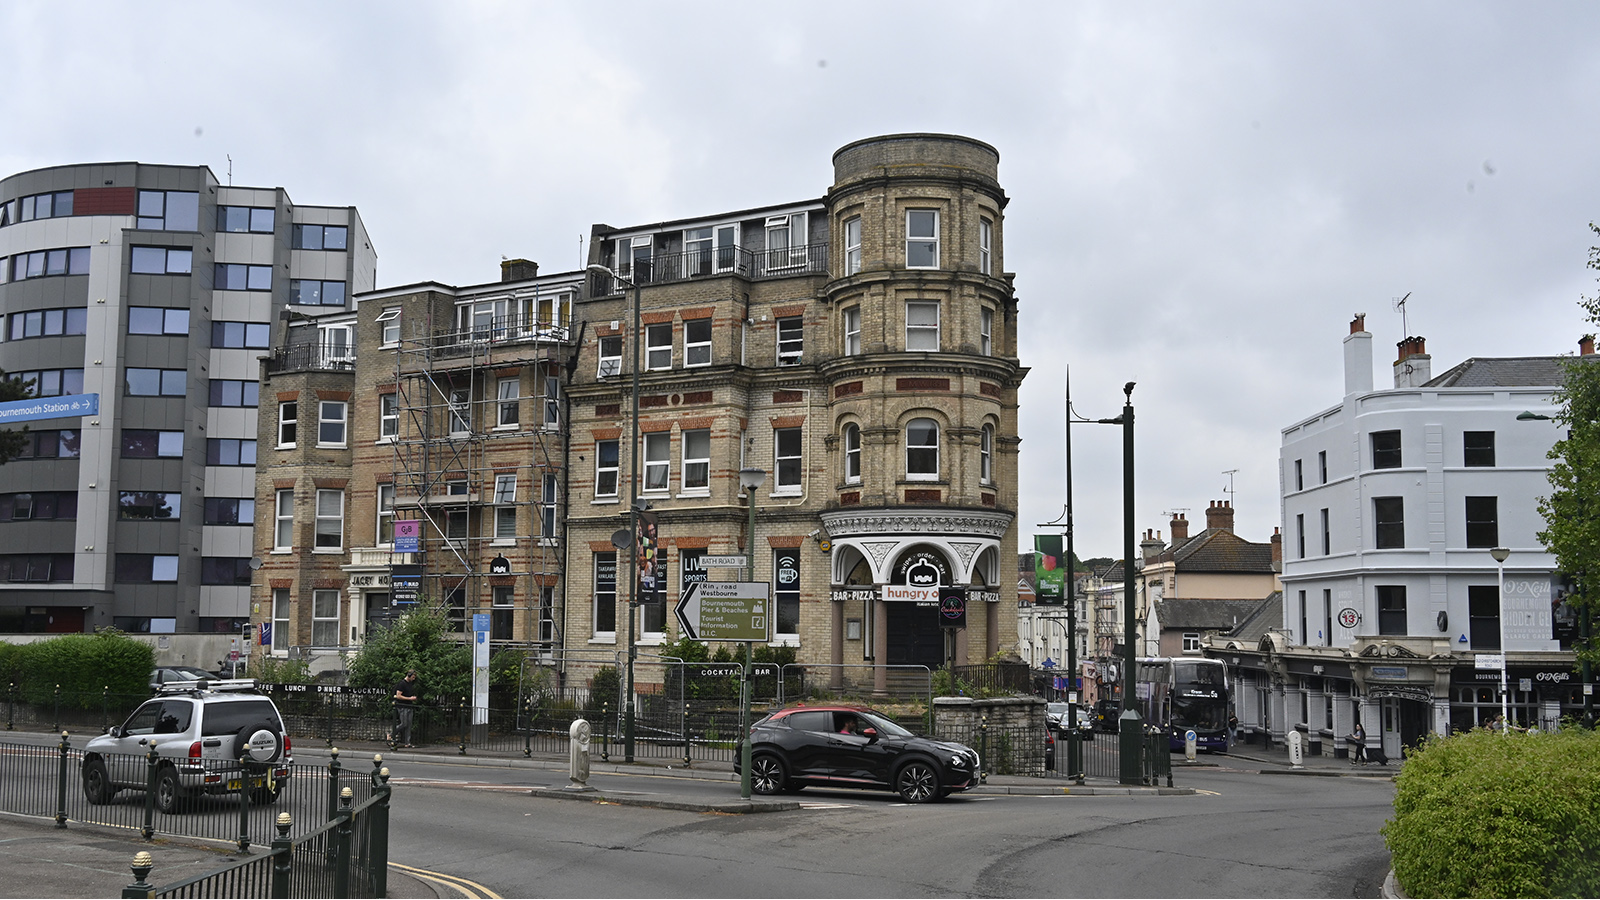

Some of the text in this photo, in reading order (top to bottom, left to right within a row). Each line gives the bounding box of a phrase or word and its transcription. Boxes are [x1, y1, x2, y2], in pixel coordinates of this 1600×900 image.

[43, 403, 70, 413] Station
[900, 557, 912, 574] swipe
[352, 576, 372, 586] JACEY
[684, 574, 707, 582] SPORTS
[833, 591, 874, 601] BAR PIZZA
[887, 587, 929, 600] hungry
[970, 592, 1000, 602] BAR PIZZA
[1344, 615, 1355, 623] 13
[1503, 611, 1536, 627] HIDDEN
[1535, 672, 1570, 683] O'Neills
